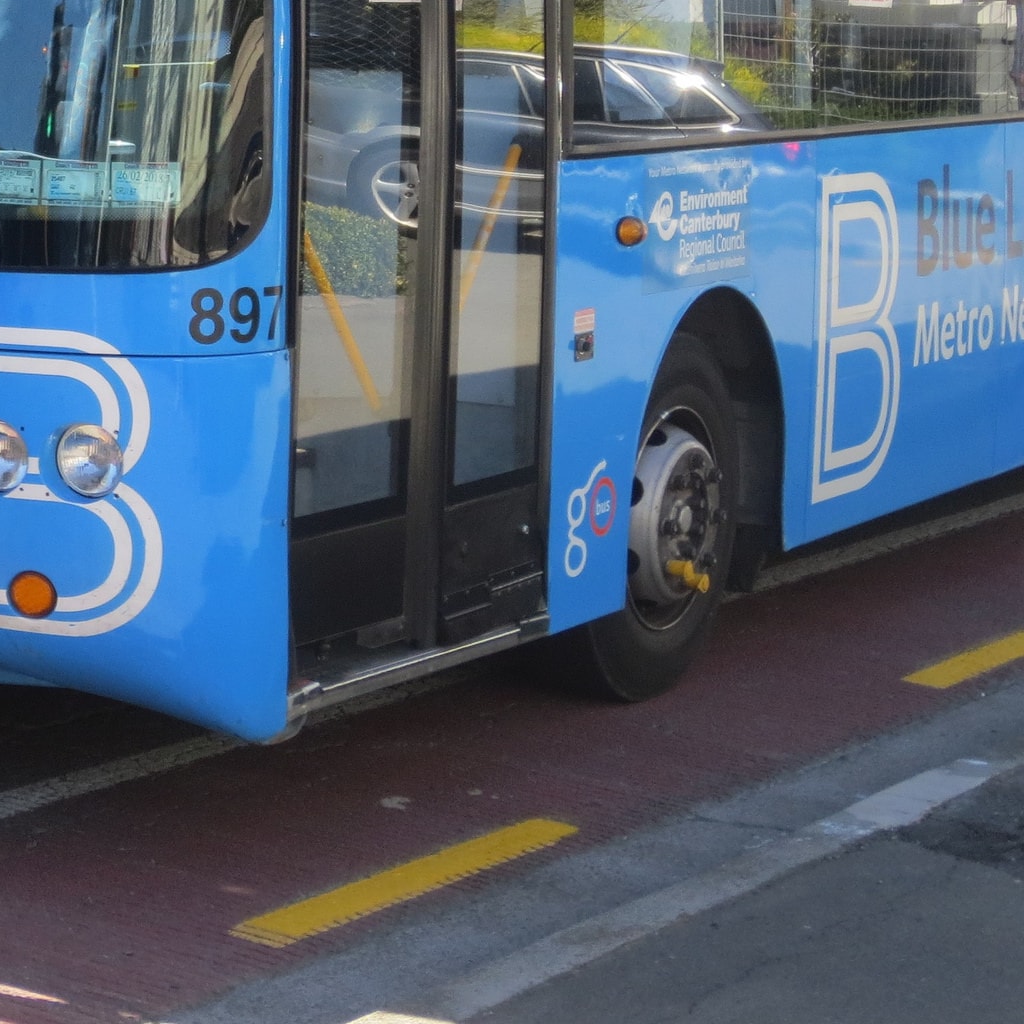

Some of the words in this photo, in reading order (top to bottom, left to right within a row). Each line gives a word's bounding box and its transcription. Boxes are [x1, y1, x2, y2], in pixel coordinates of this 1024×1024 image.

[679, 184, 749, 212] Environment
[679, 209, 741, 235] Canterbury
[917, 163, 996, 277] Blue
[679, 234, 715, 263] Regional
[716, 230, 746, 253] Council
[188, 285, 283, 345] 897
[811, 171, 901, 505] B
[913, 300, 994, 367] Metro
